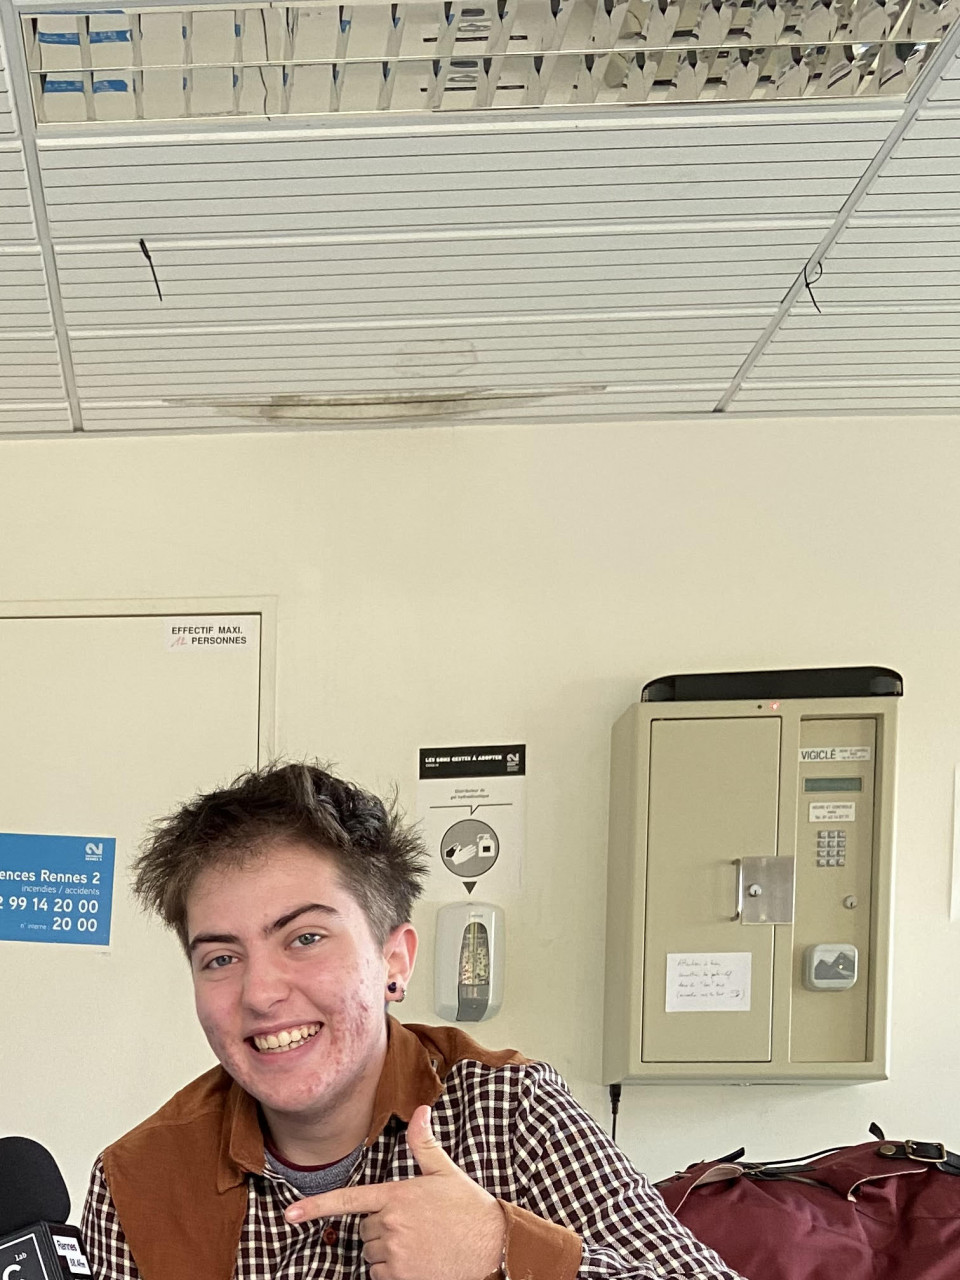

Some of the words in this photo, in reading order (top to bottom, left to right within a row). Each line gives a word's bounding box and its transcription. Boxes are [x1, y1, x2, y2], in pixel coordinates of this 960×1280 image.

[172, 626, 214, 634] EFFECTIF
[192, 637, 246, 645] PERSONNES
[801, 749, 836, 760] VIGICLÉ
[41, 870, 87, 883] Rennes
[92, 872, 100, 884] 2
[22, 885, 56, 893] incendies
[65, 887, 99, 895] accidents
[9, 896, 27, 910] 99
[33, 898, 48, 911] 14
[54, 899, 72, 912] 20
[79, 900, 98, 913] 00
[52, 917, 71, 930] 20
[77, 918, 97, 931] 00
